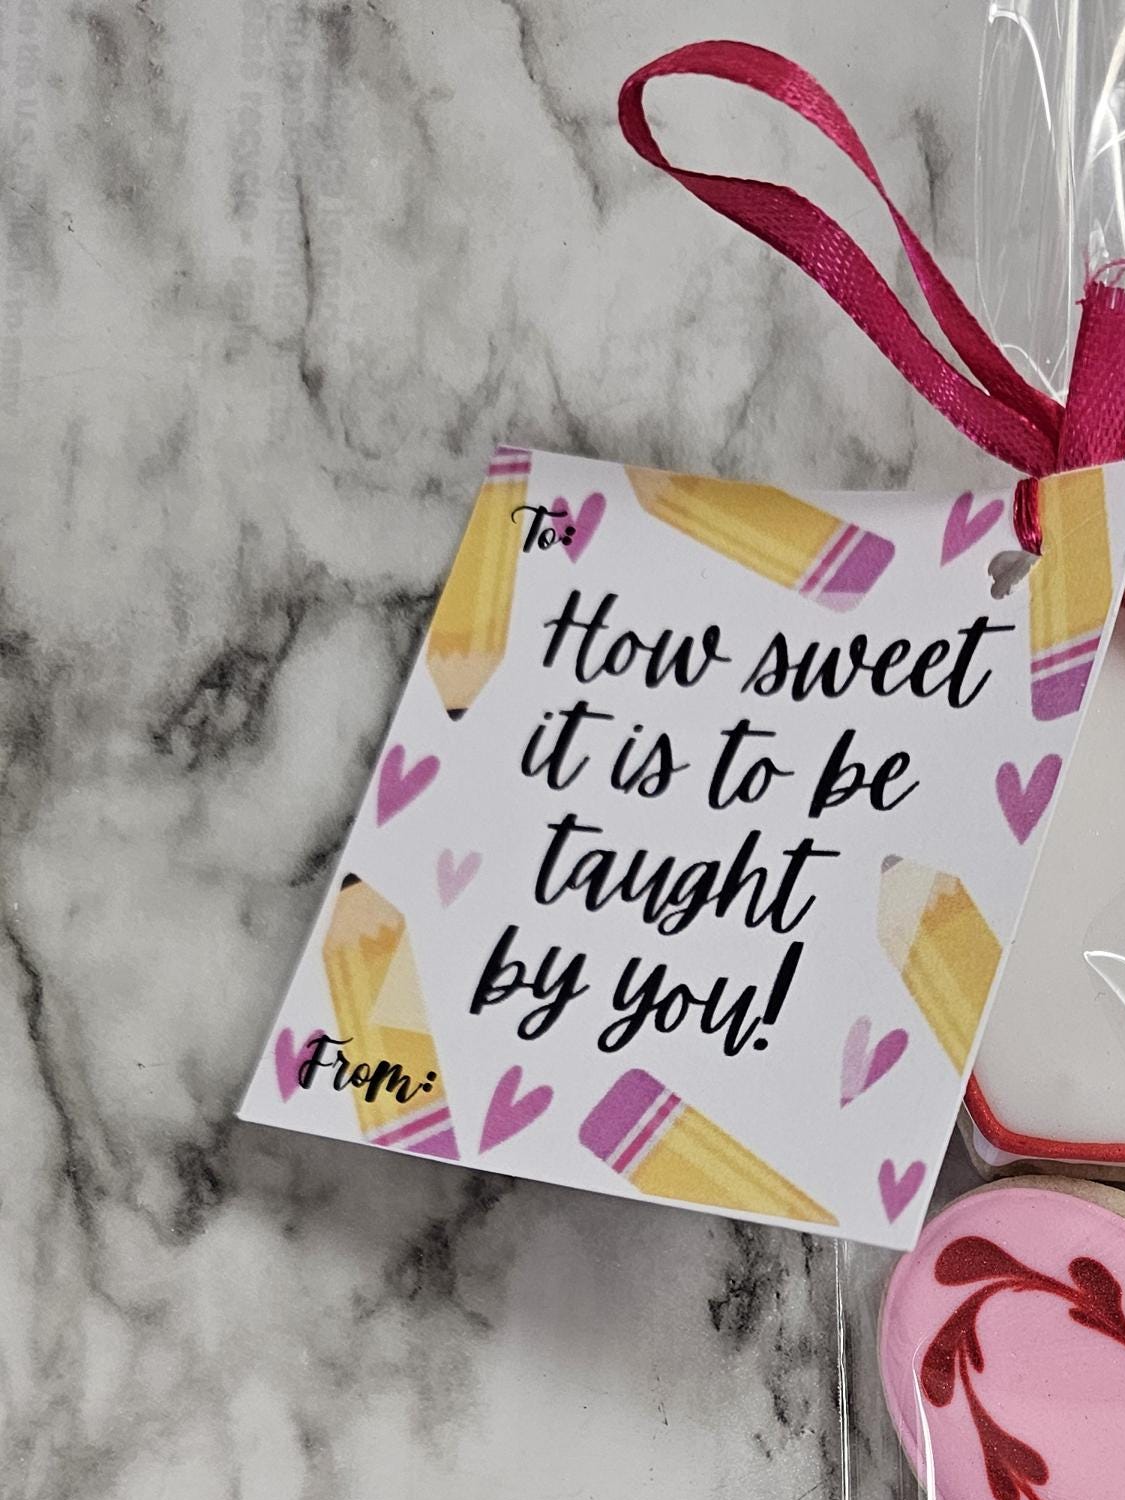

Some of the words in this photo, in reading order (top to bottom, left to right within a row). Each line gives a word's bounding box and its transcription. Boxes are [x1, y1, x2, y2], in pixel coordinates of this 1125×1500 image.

[511, 505, 577, 553] To:
[542, 589, 732, 688] How
[740, 616, 1016, 709] sweet
[521, 700, 614, 790] it
[610, 724, 691, 798] is
[708, 718, 795, 810] to
[808, 728, 920, 819] be
[534, 813, 841, 936] taught
[469, 924, 590, 1041] by
[598, 941, 806, 1057] you!
[297, 1034, 437, 1104] From:
